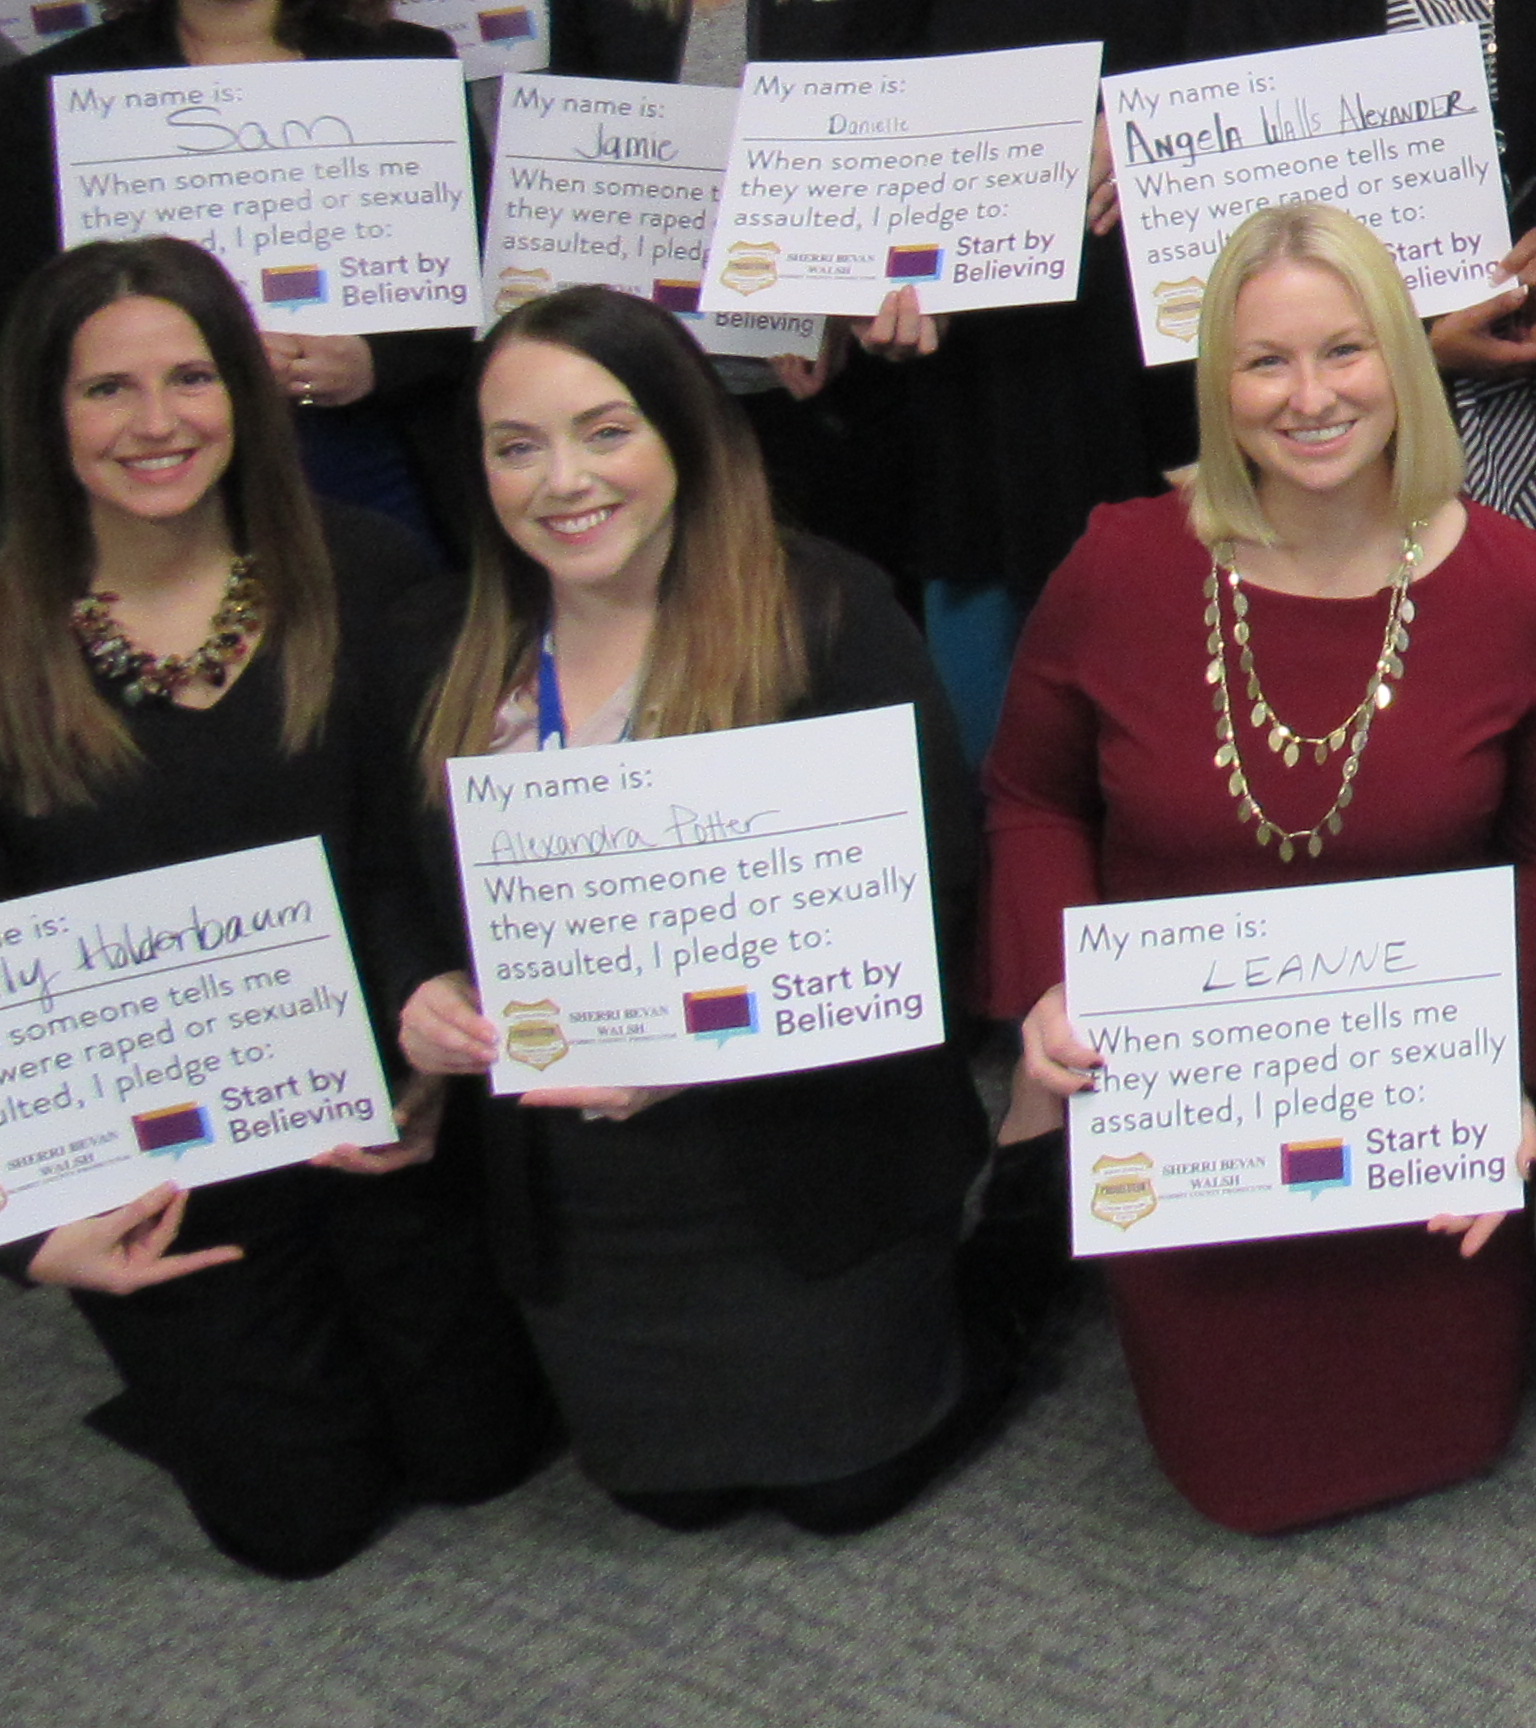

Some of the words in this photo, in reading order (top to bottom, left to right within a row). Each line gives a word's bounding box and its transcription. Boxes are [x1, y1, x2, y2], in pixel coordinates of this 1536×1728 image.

[512, 86, 555, 118] My
[564, 98, 632, 117] name
[641, 95, 664, 118] is:
[167, 107, 352, 153] Sam
[1203, 939, 1419, 992] LEANNE
